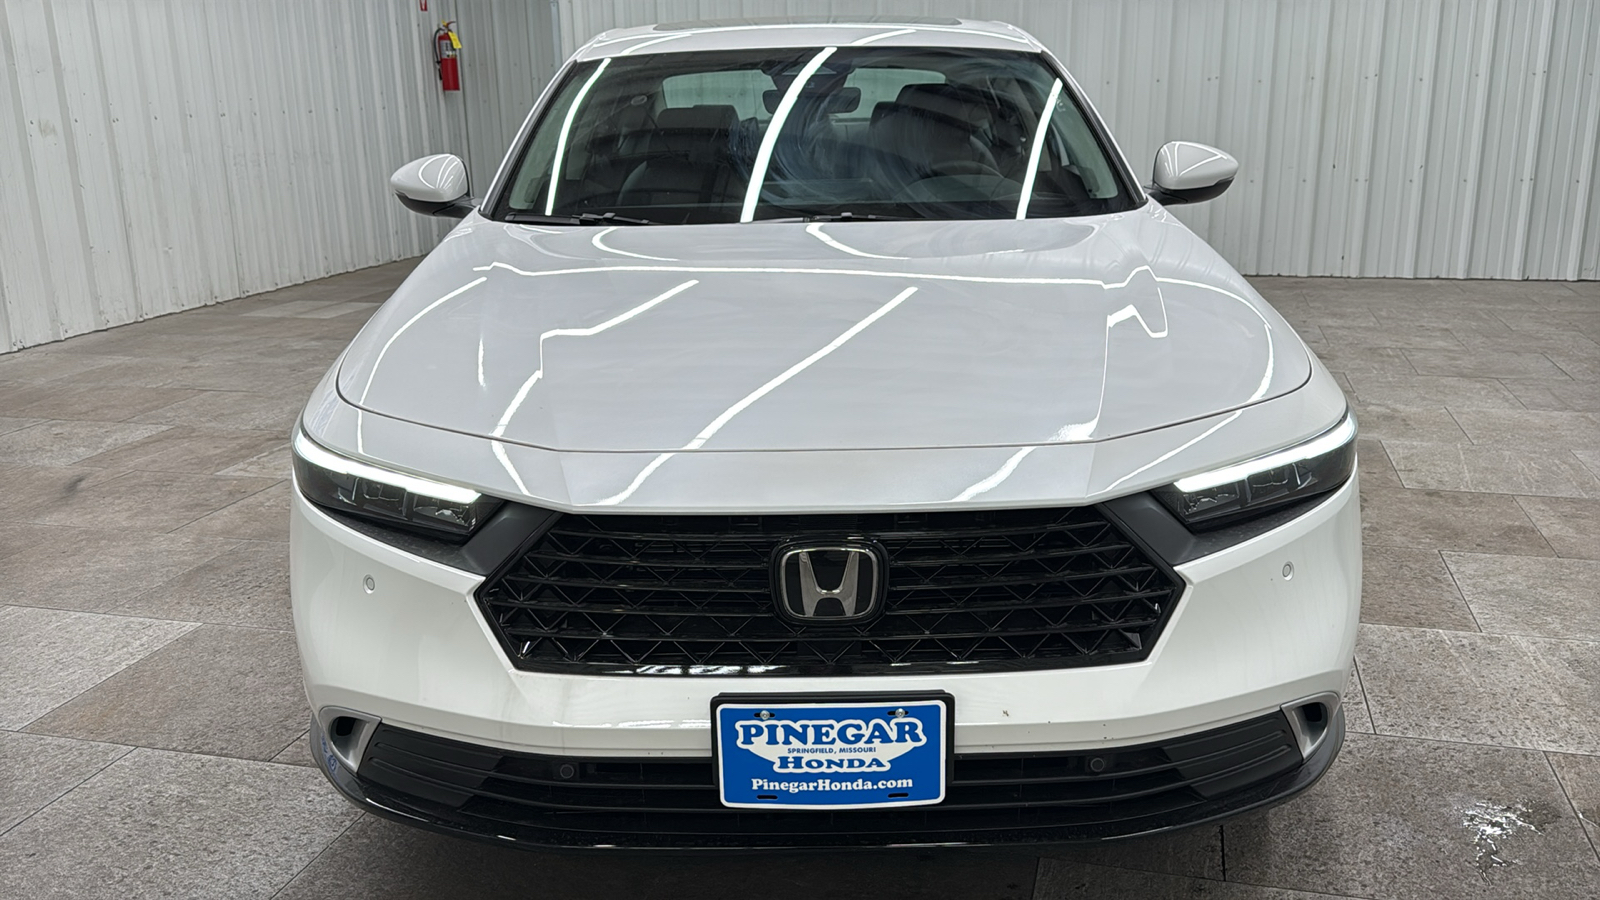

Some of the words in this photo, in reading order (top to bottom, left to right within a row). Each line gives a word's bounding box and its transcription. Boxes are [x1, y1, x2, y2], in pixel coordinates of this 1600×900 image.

[739, 721, 923, 746] PINEGAR
[787, 747, 837, 755] SPRINGFIELD,
[838, 746, 877, 754] MISSOURI
[777, 756, 888, 770] HONDA
[751, 778, 914, 794] PinegarHonda.com
